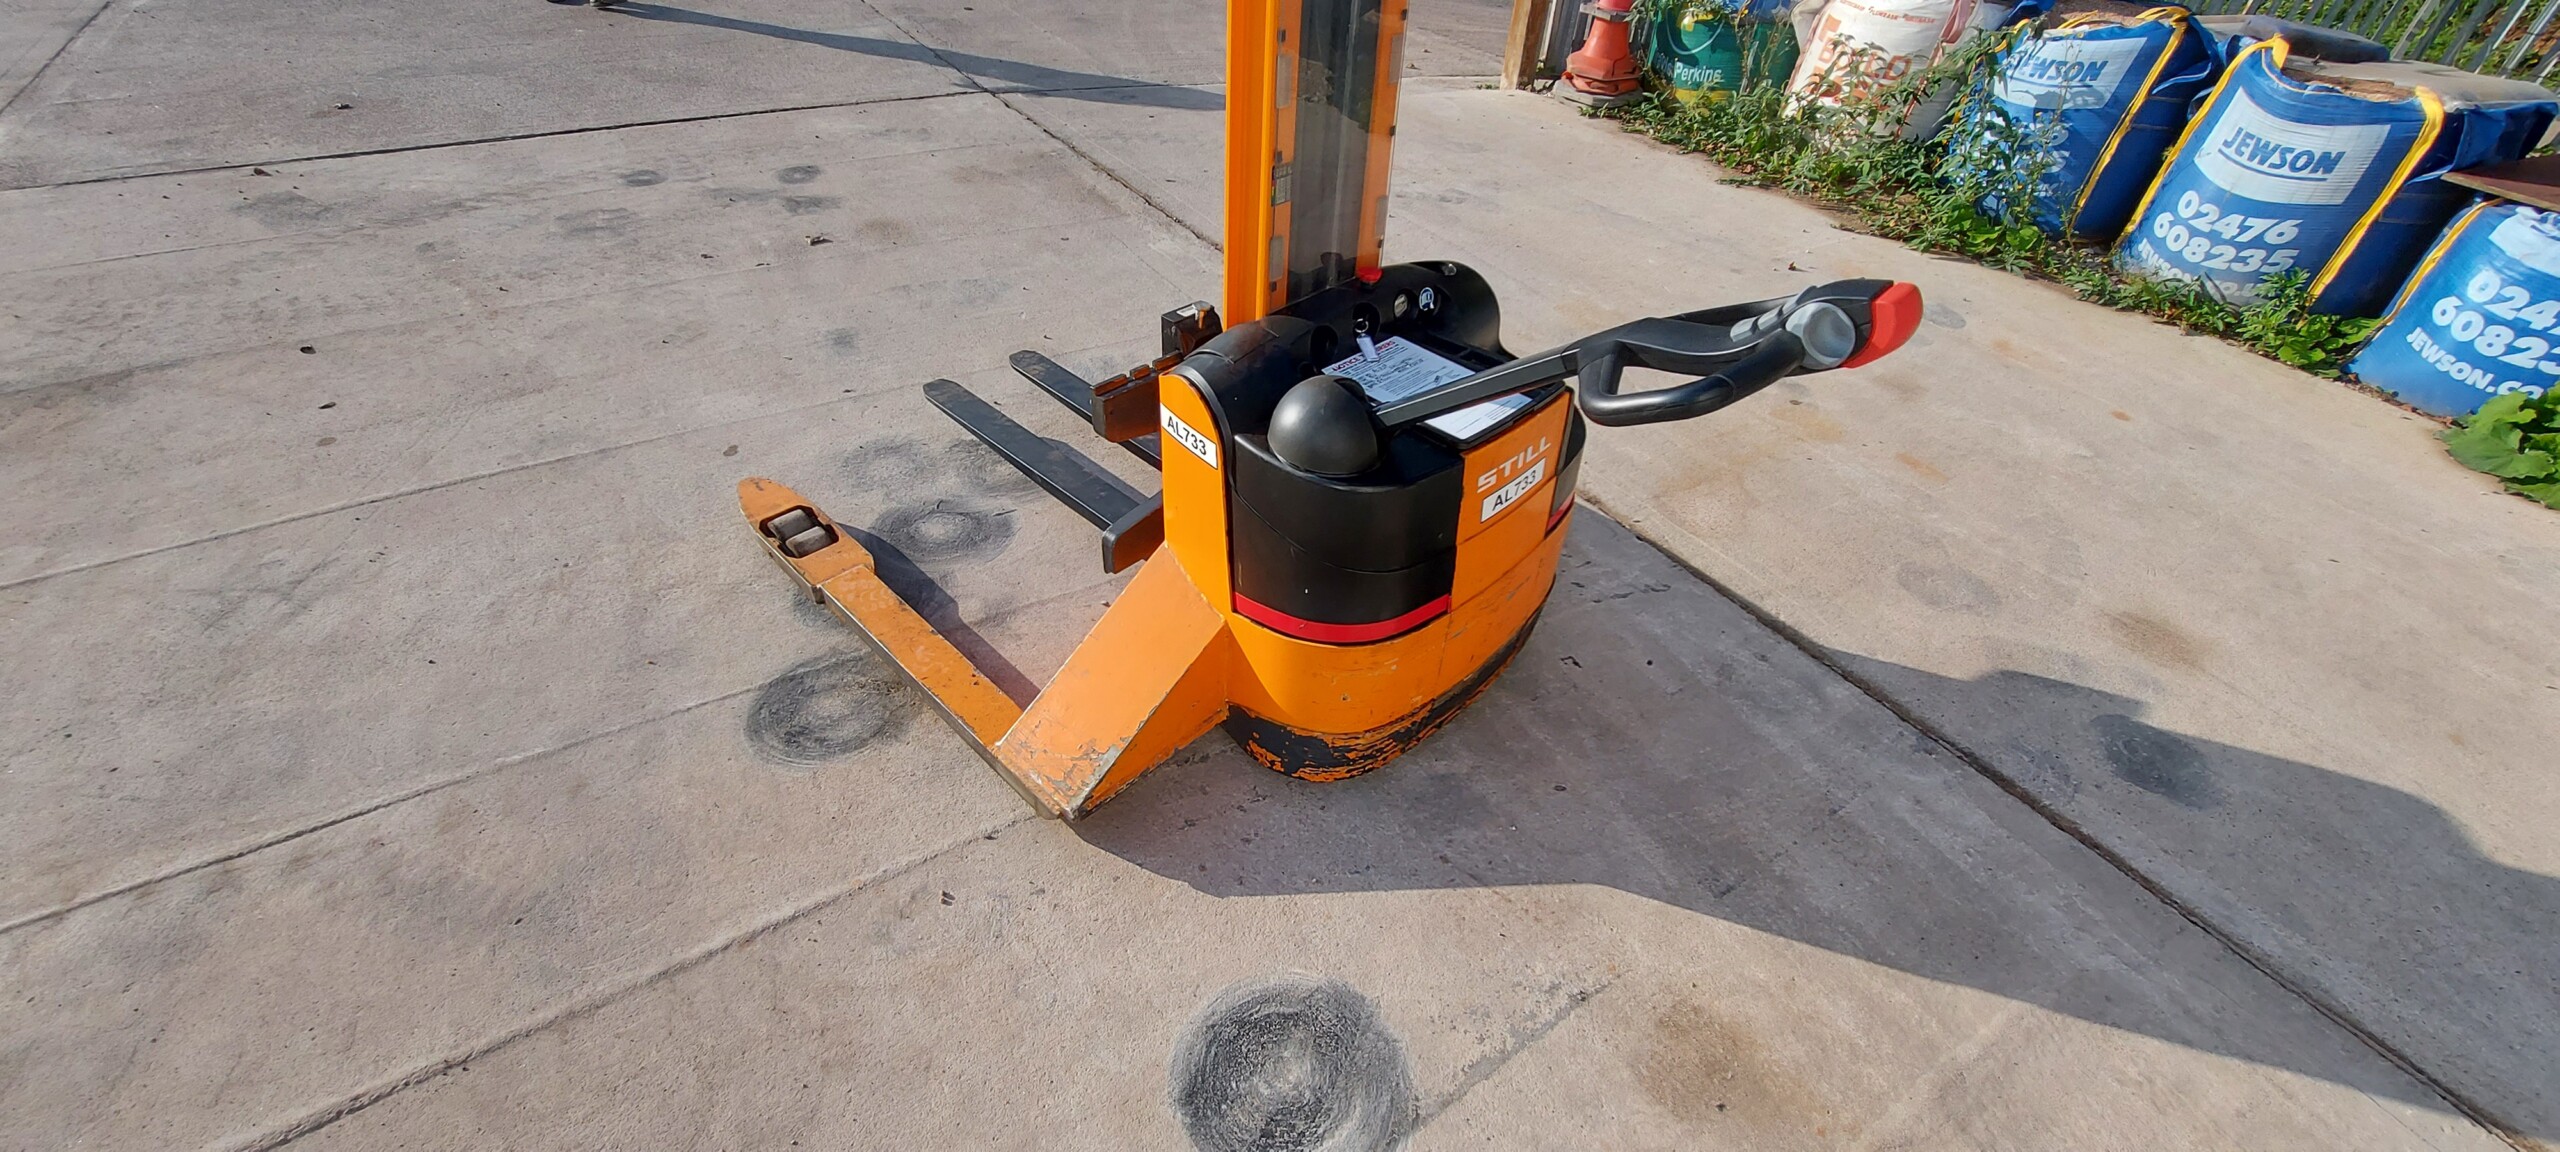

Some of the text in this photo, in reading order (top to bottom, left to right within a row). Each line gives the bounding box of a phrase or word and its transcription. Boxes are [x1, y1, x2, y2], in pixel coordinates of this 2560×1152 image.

[1674, 61, 1721, 82] Perkins
[2004, 50, 2109, 82] EWSON
[2221, 126, 2346, 175] JEWSON
[2177, 190, 2303, 245] 02476
[2153, 212, 2300, 273] 608235
[2467, 268, 2560, 336] 024
[1167, 415, 1207, 456] AL733
[1477, 436, 1551, 493] STILL
[1492, 469, 1536, 511] AL733
